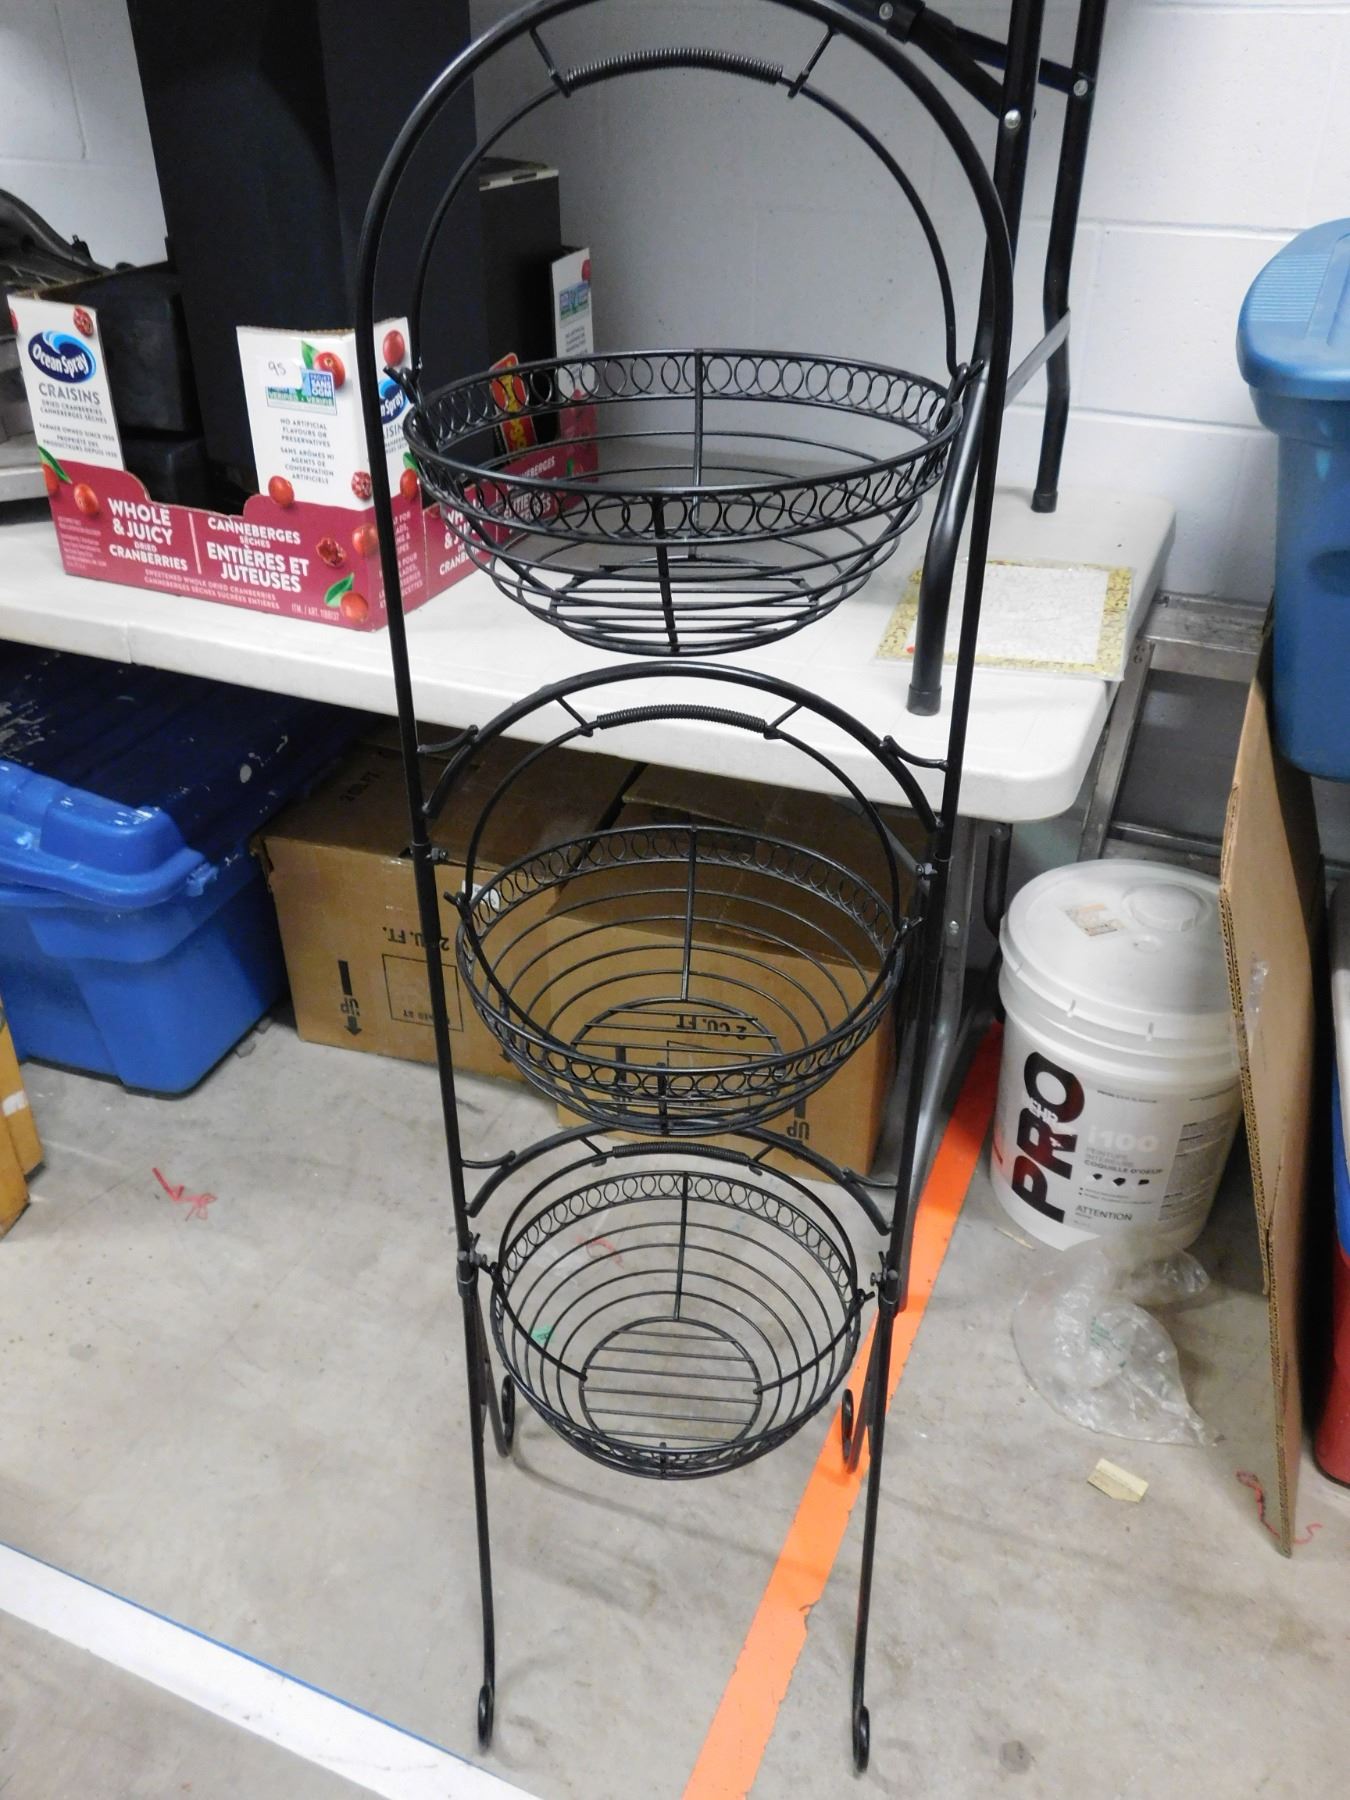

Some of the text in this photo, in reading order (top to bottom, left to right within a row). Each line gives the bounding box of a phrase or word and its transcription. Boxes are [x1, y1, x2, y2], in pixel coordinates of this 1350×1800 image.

[32, 343, 89, 378] Ocean Spray
[311, 380, 332, 390] SANS
[312, 387, 333, 398] OGM
[39, 383, 101, 405] CRAISINS
[282, 427, 316, 438] FLAVOURS
[292, 419, 327, 431] ARTIFICIAL
[281, 435, 331, 448] PRESERVATIVES
[280, 447, 297, 456] SANS
[291, 457, 316, 466] AGENTS
[284, 464, 334, 477] CONSERVATION
[292, 473, 329, 485] ARTIFICIELS
[107, 497, 172, 527] WHOLE
[112, 518, 125, 536] &
[126, 520, 173, 545] JUICY
[207, 517, 301, 545] CANNEBERGES
[133, 540, 157, 553] DRIED
[108, 543, 188, 572] CRANBERRIES
[206, 541, 309, 577] ENTIÈRES ET
[220, 562, 302, 593] JUTEUSES
[382, 926, 406, 944] FT.
[340, 998, 361, 1017] UP
[702, 1018, 731, 1037] CU.
[736, 1025, 747, 1040] 2
[787, 1120, 810, 1140] UP
[1012, 1051, 1085, 1224] PRO
[1084, 1159, 1129, 1174] COQUILLE
[1076, 1204, 1133, 1221] ATTENTION
